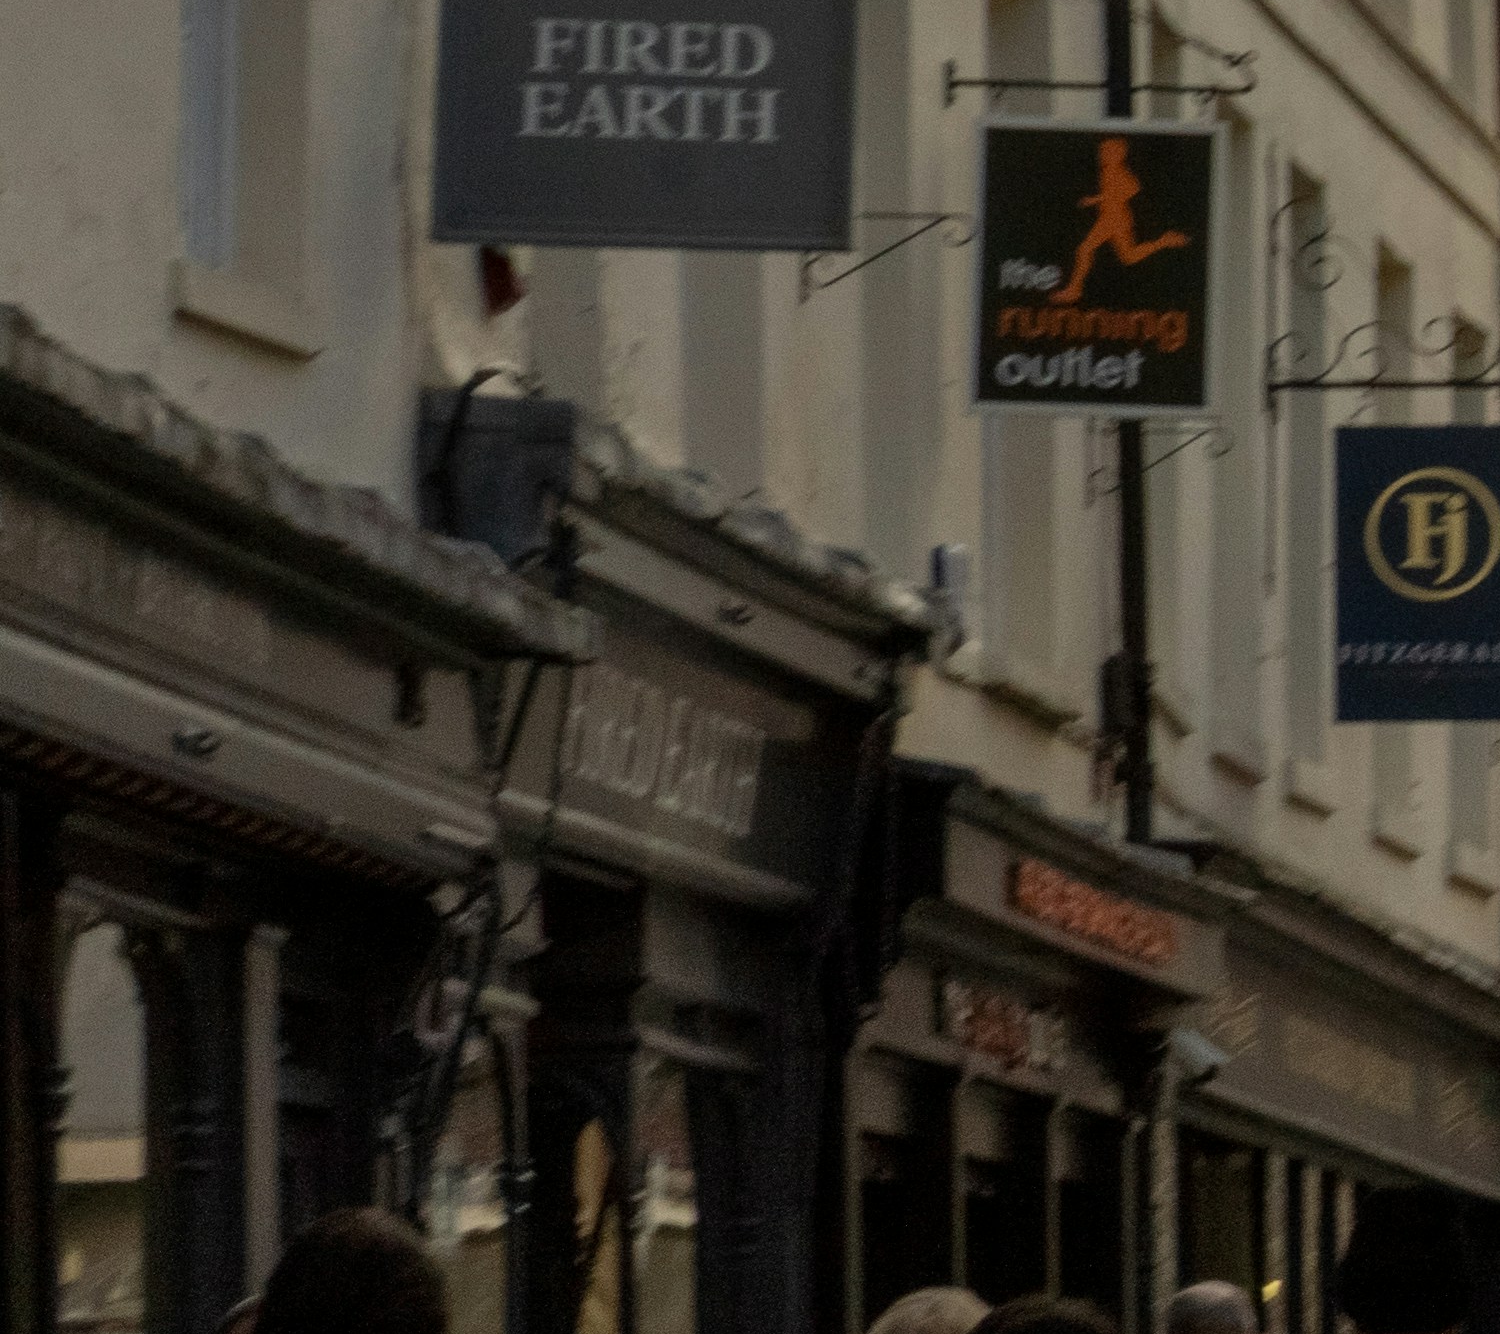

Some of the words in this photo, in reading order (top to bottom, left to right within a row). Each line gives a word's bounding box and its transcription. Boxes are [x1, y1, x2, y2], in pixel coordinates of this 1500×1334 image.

[529, 17, 776, 79] FIRED
[517, 80, 784, 144] EARTH
[999, 257, 1062, 291] the
[996, 305, 1188, 353] running
[994, 345, 1145, 389] outlet
